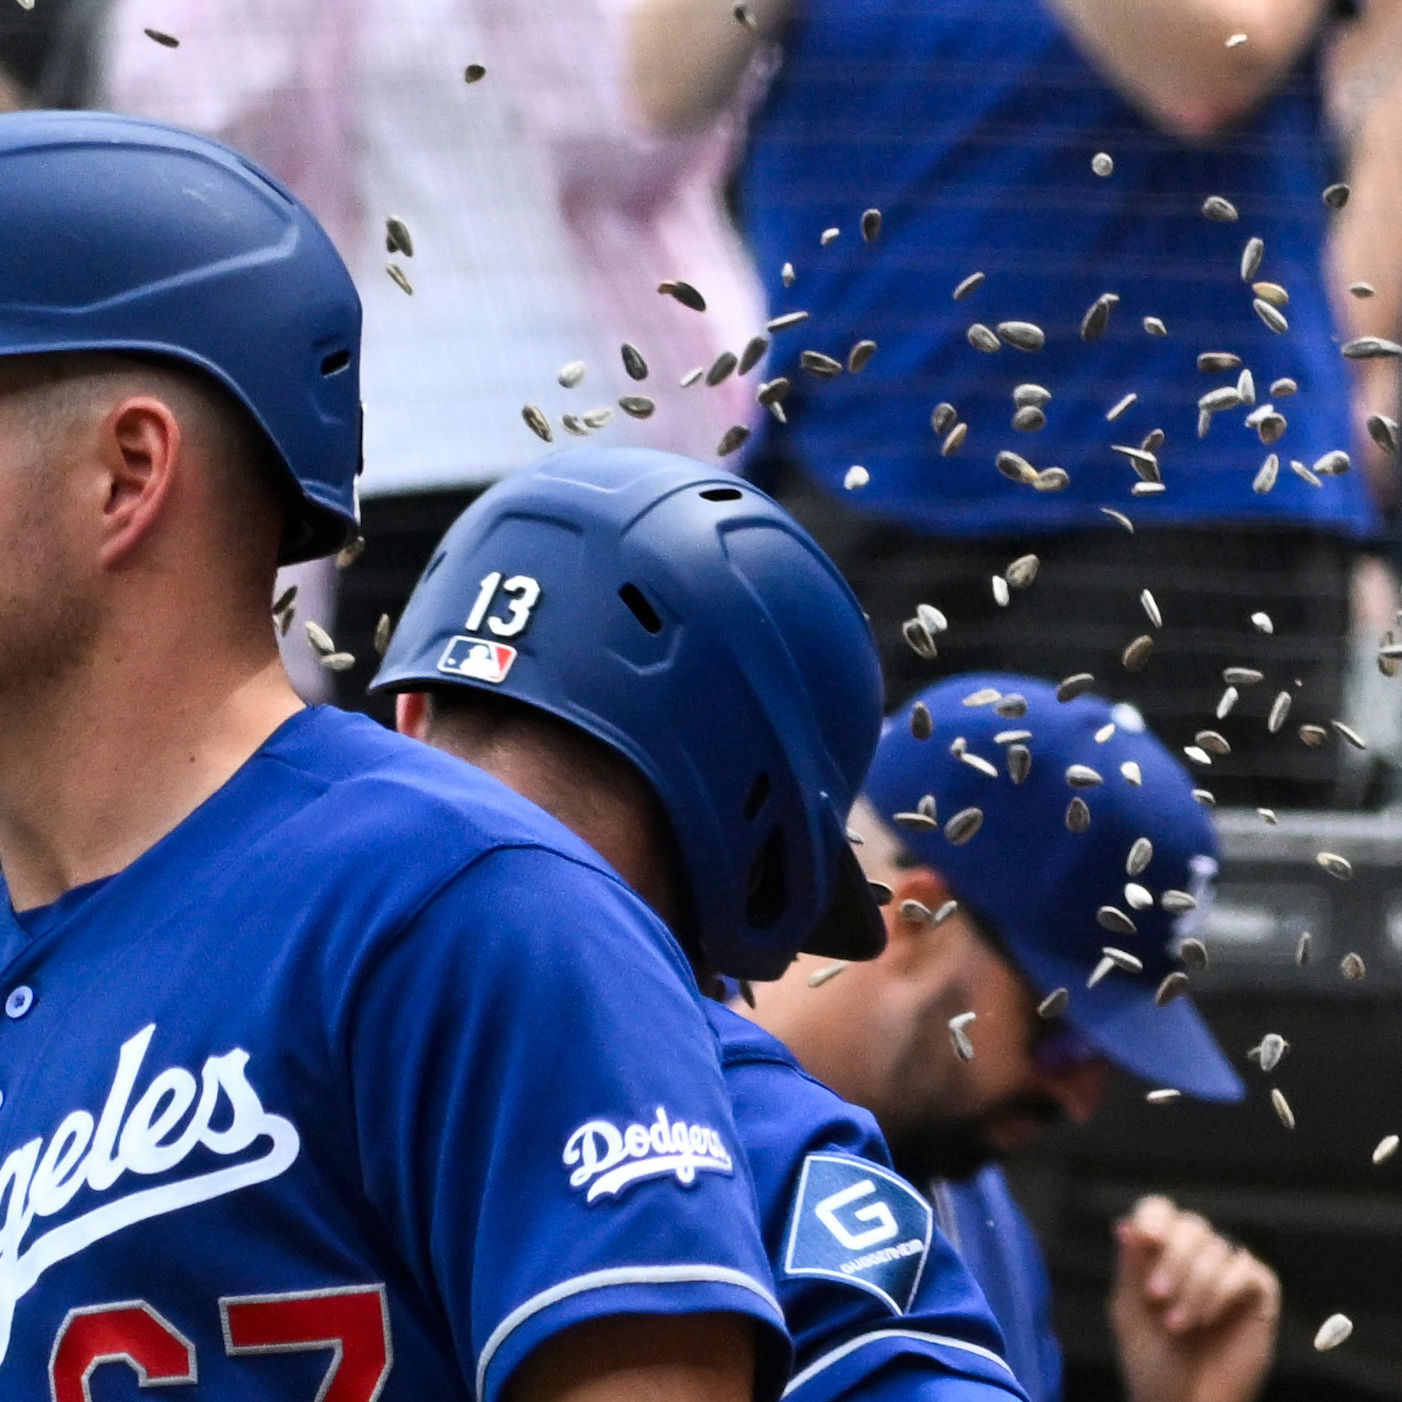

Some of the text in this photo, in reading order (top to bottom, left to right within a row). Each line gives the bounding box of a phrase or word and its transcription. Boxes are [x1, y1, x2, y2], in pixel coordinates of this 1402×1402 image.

[464, 570, 541, 637] 13
[563, 1106, 732, 1202] Dodgers
[815, 1180, 898, 1250] G
